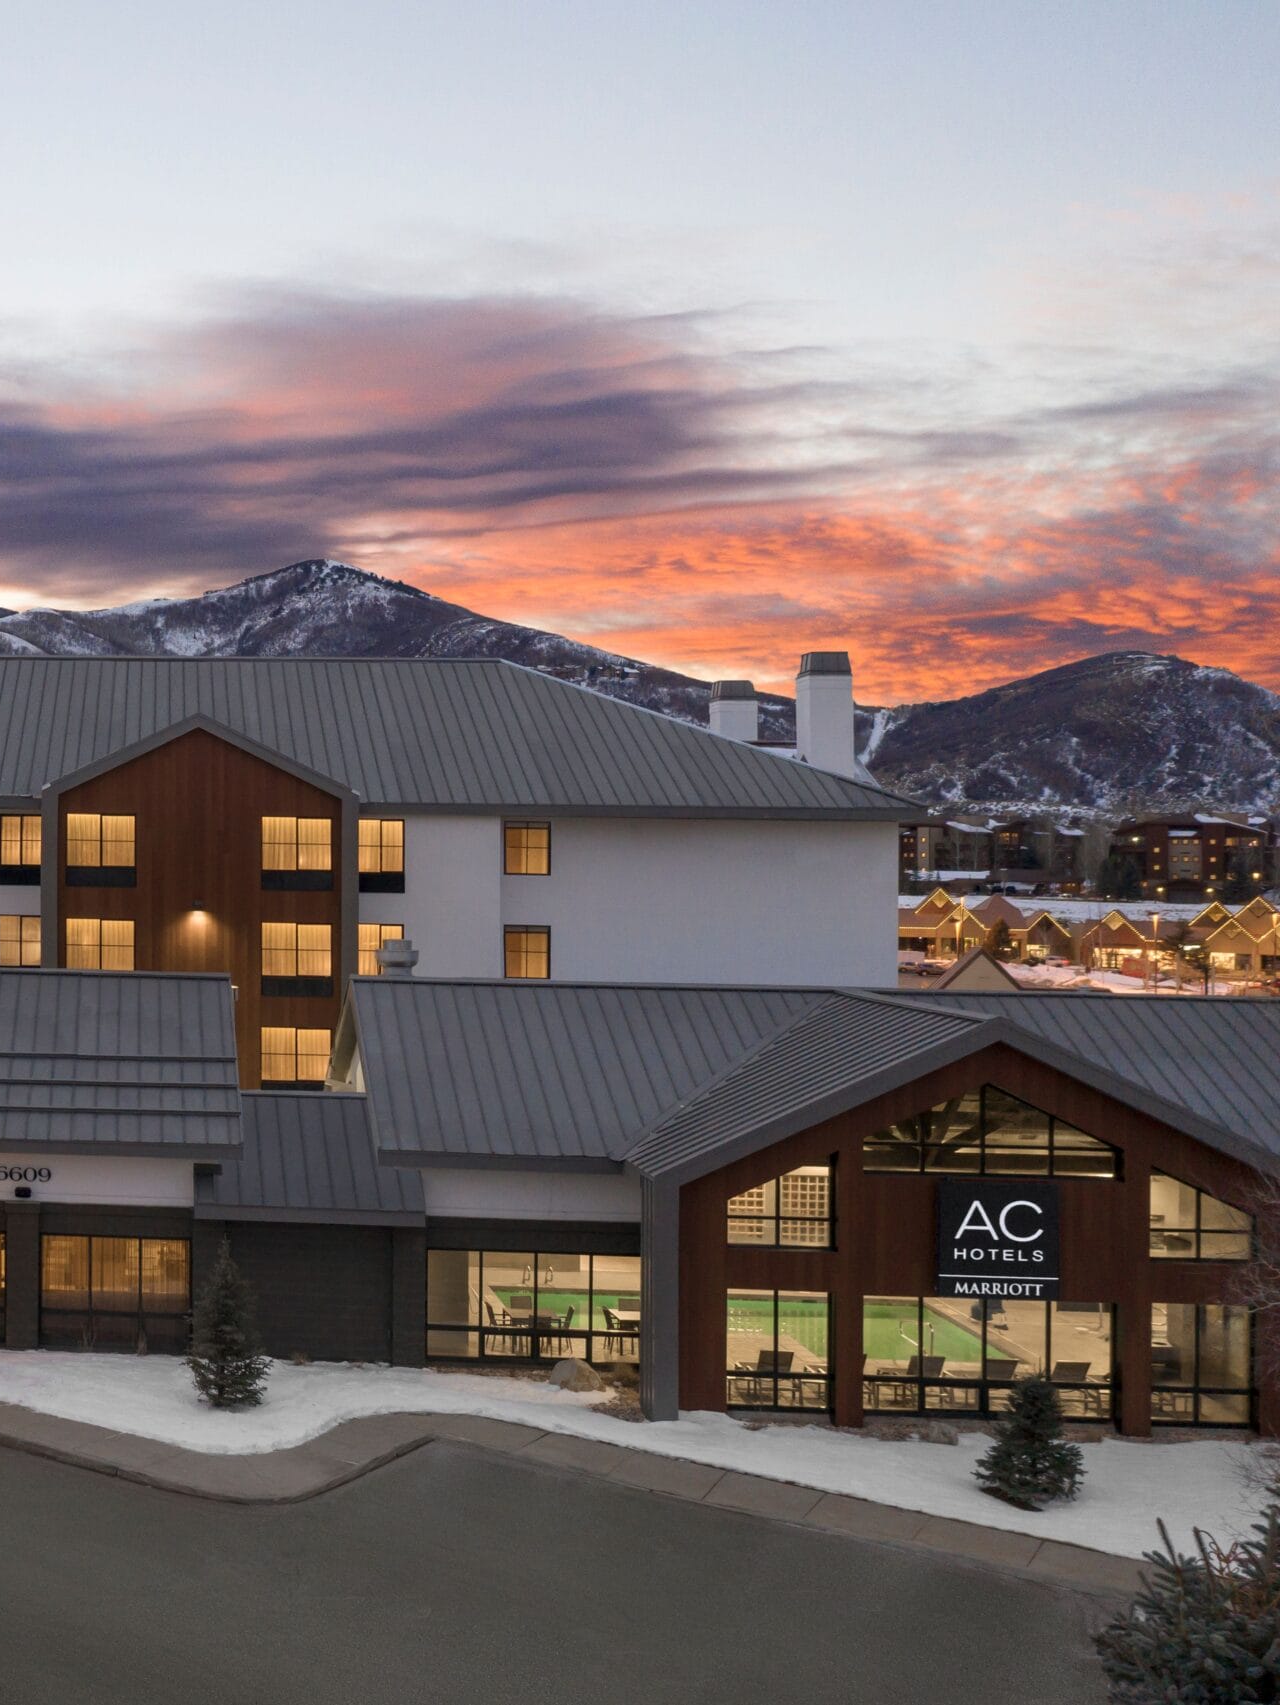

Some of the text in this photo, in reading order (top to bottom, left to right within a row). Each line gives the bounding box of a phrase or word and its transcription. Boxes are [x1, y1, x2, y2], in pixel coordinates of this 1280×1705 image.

[954, 1200, 1044, 1242] AC
[954, 1248, 1044, 1262] HOTELS
[954, 1281, 1044, 1296] MARRIOTT
